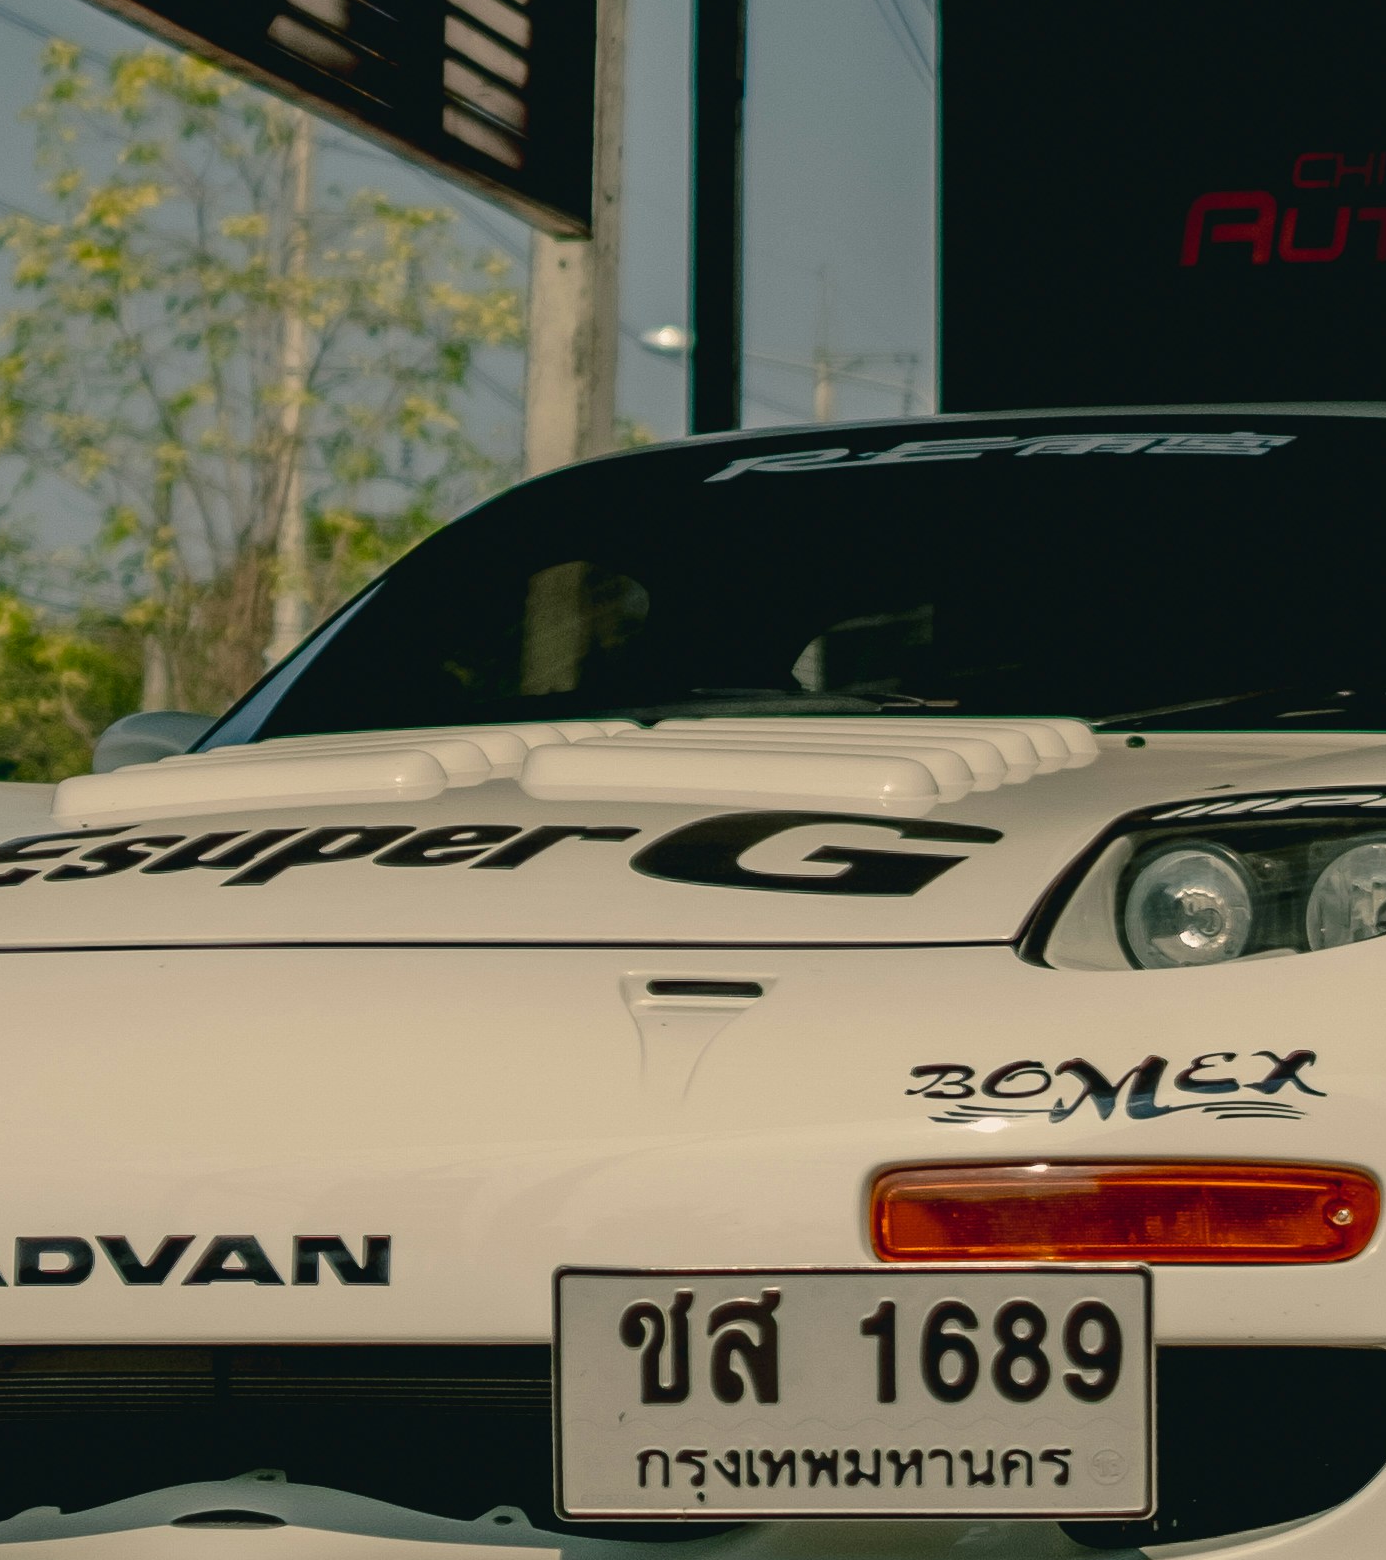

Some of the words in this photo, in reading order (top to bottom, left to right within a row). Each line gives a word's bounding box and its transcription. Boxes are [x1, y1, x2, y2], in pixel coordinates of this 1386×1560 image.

[904, 1049, 1327, 1123] BOMEX
[619, 1288, 781, 1405] ชส
[859, 1298, 1125, 1405] 1689
[636, 1447, 1074, 1502] กรุงเทพมหานคร
